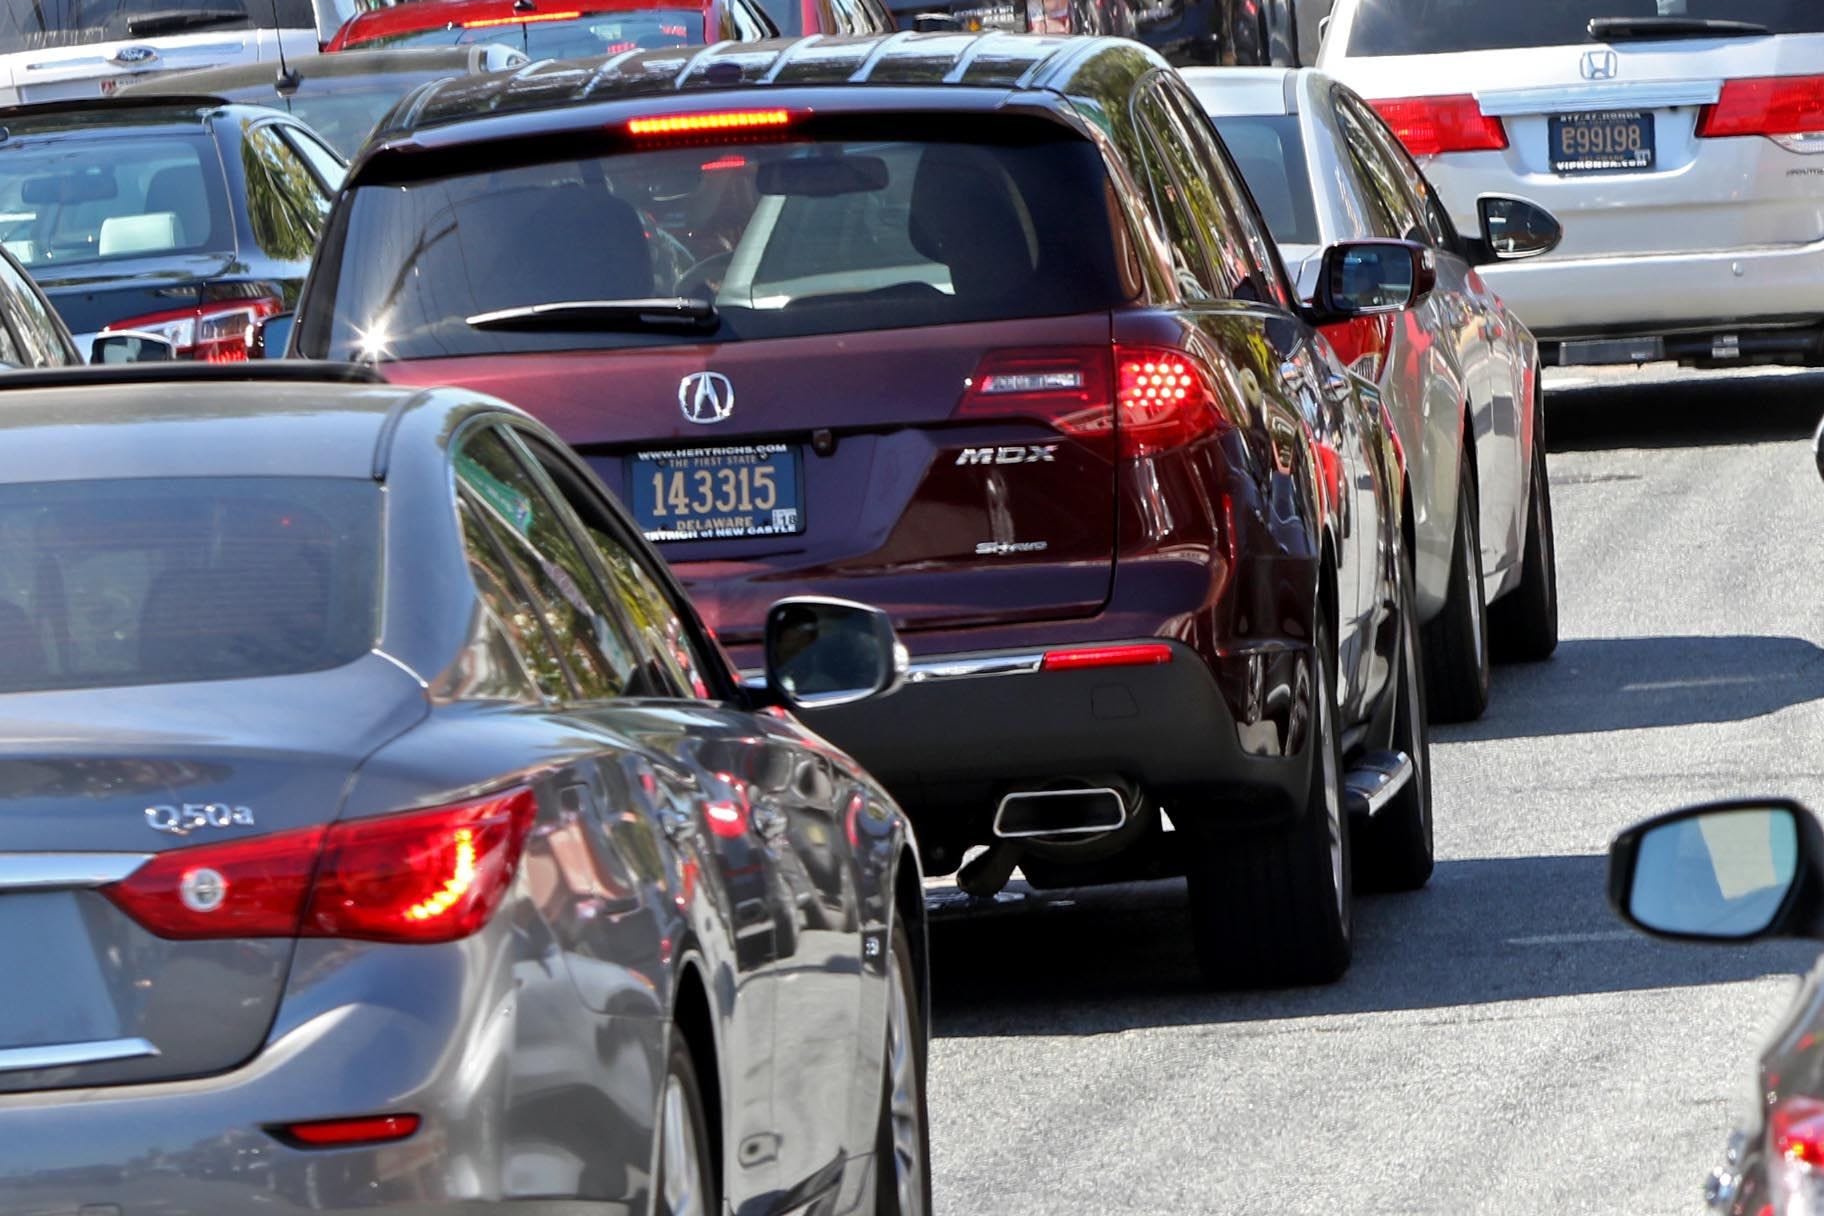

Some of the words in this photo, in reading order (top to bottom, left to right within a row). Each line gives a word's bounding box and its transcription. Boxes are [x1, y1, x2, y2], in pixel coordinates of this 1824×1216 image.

[637, 443, 788, 461] WWW.HERTRICHS.COM
[955, 444, 1059, 466] MDX
[669, 459, 689, 468] THE
[694, 457, 722, 467] FIRST
[727, 455, 757, 464] STATE
[652, 466, 777, 516] 143315
[676, 516, 754, 531] DELAWARE
[643, 530, 698, 542] RTRICH
[715, 528, 745, 537] NEW
[747, 525, 797, 535] CASTLE
